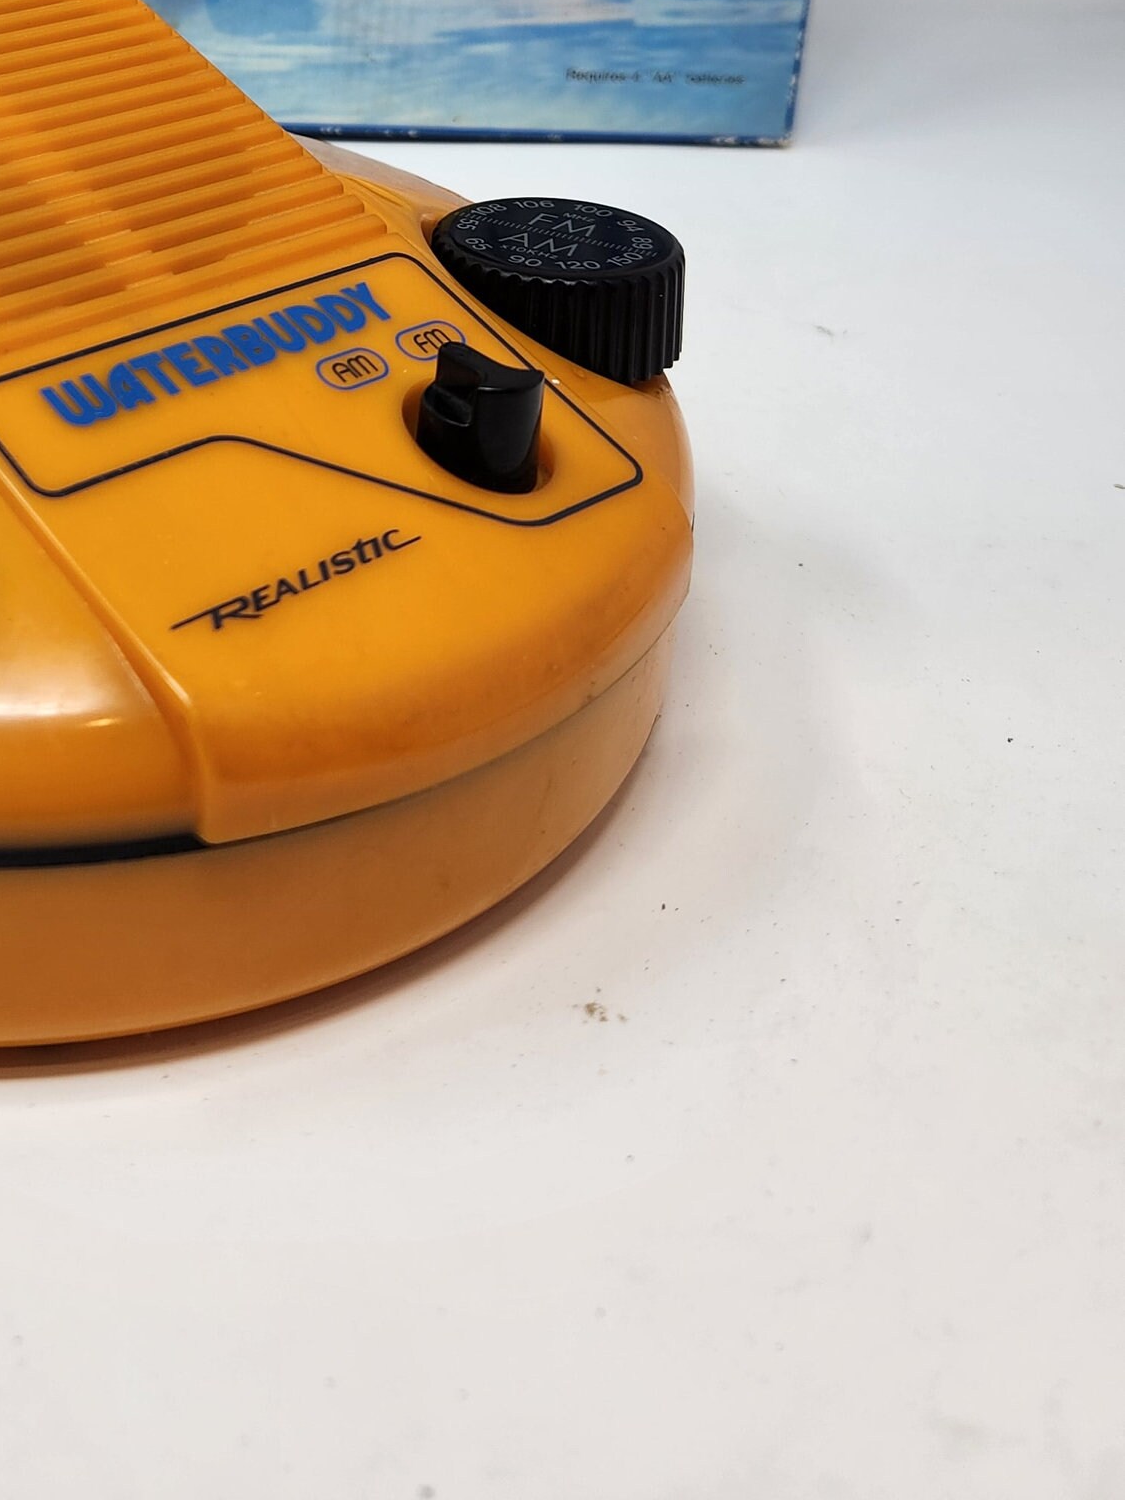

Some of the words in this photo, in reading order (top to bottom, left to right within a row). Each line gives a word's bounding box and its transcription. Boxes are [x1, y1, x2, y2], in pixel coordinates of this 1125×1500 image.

[471, 203, 508, 217] 108
[513, 199, 556, 209] 106
[574, 203, 614, 218] 100
[528, 212, 596, 238] FM
[616, 219, 645, 233] 94
[465, 237, 493, 252] 65
[498, 232, 579, 258] AM
[508, 254, 543, 268] 90
[554, 259, 601, 271] 120
[606, 251, 644, 268] 150
[39, 281, 392, 428] WATERBUDDY
[332, 353, 380, 383] AM
[170, 528, 422, 631] REALISTIC
